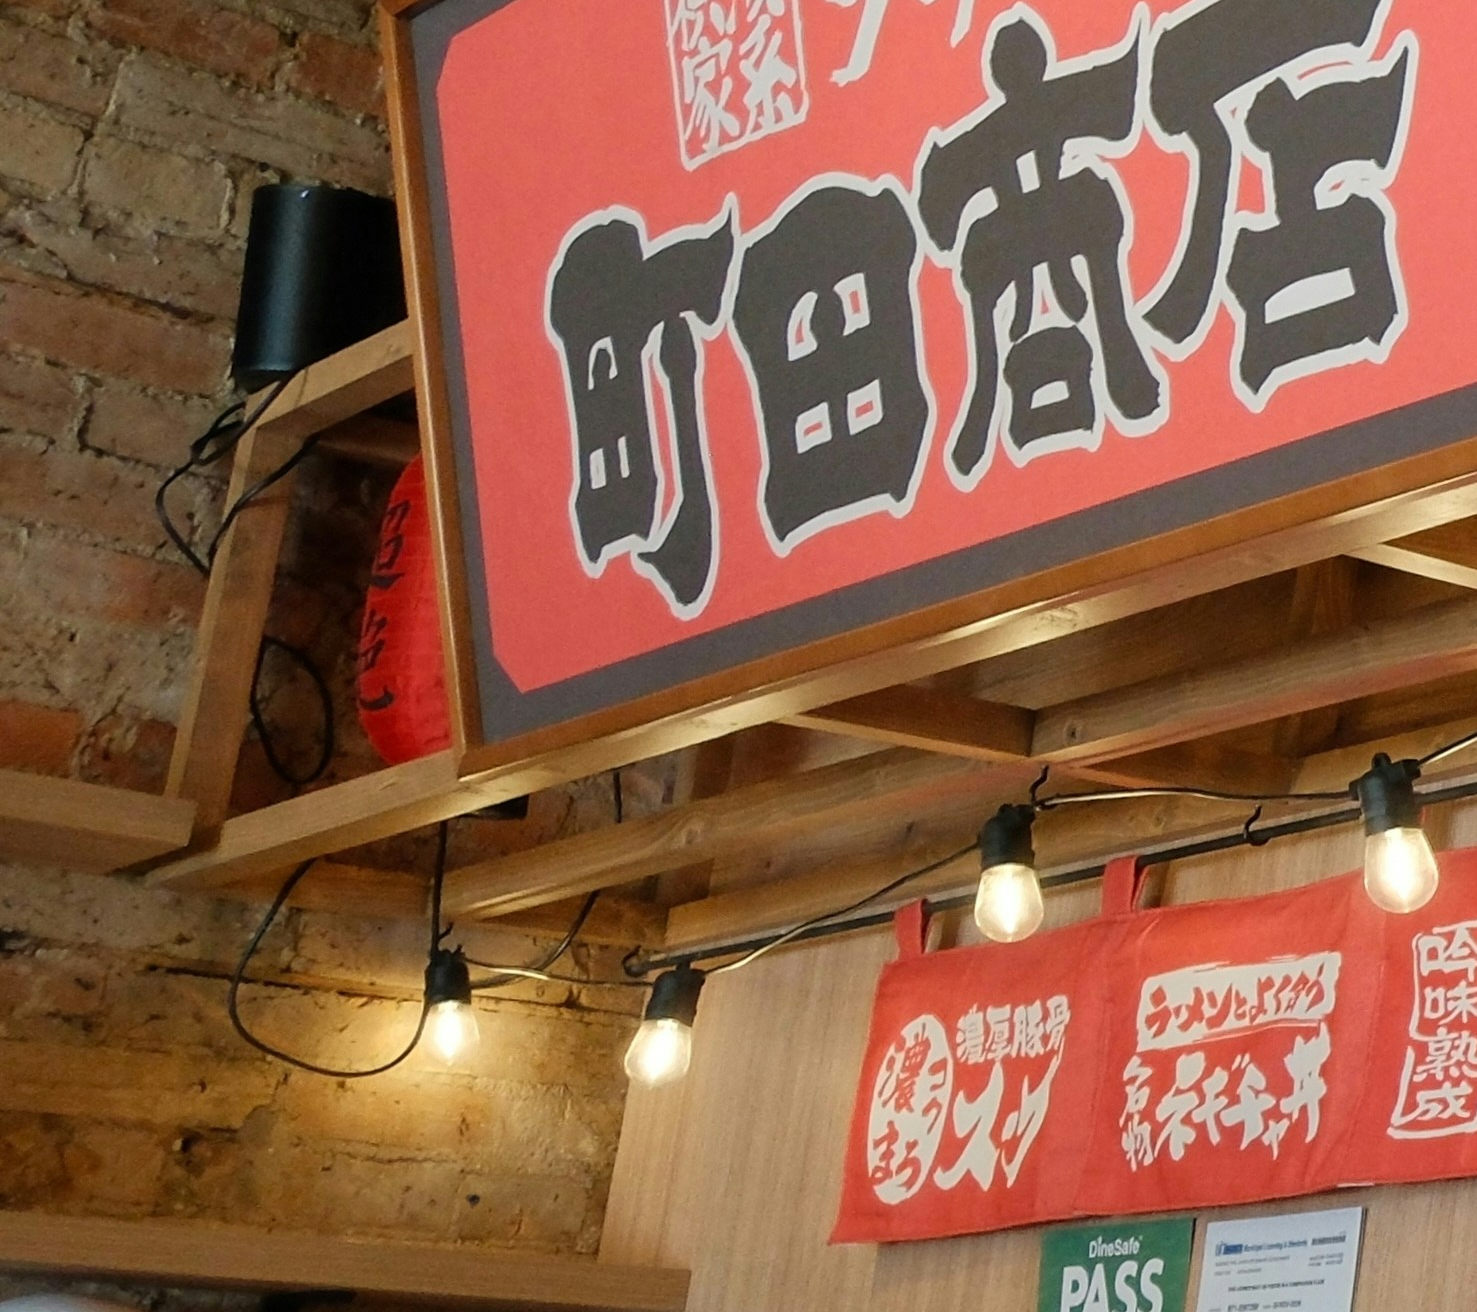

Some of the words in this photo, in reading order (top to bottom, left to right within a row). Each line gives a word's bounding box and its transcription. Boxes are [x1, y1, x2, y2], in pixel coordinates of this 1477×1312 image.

[956, 994, 1071, 1066] 濃厚豚骨
[1118, 1054, 1154, 1173] 名物
[1088, 1235, 1140, 1259] DineSafe
